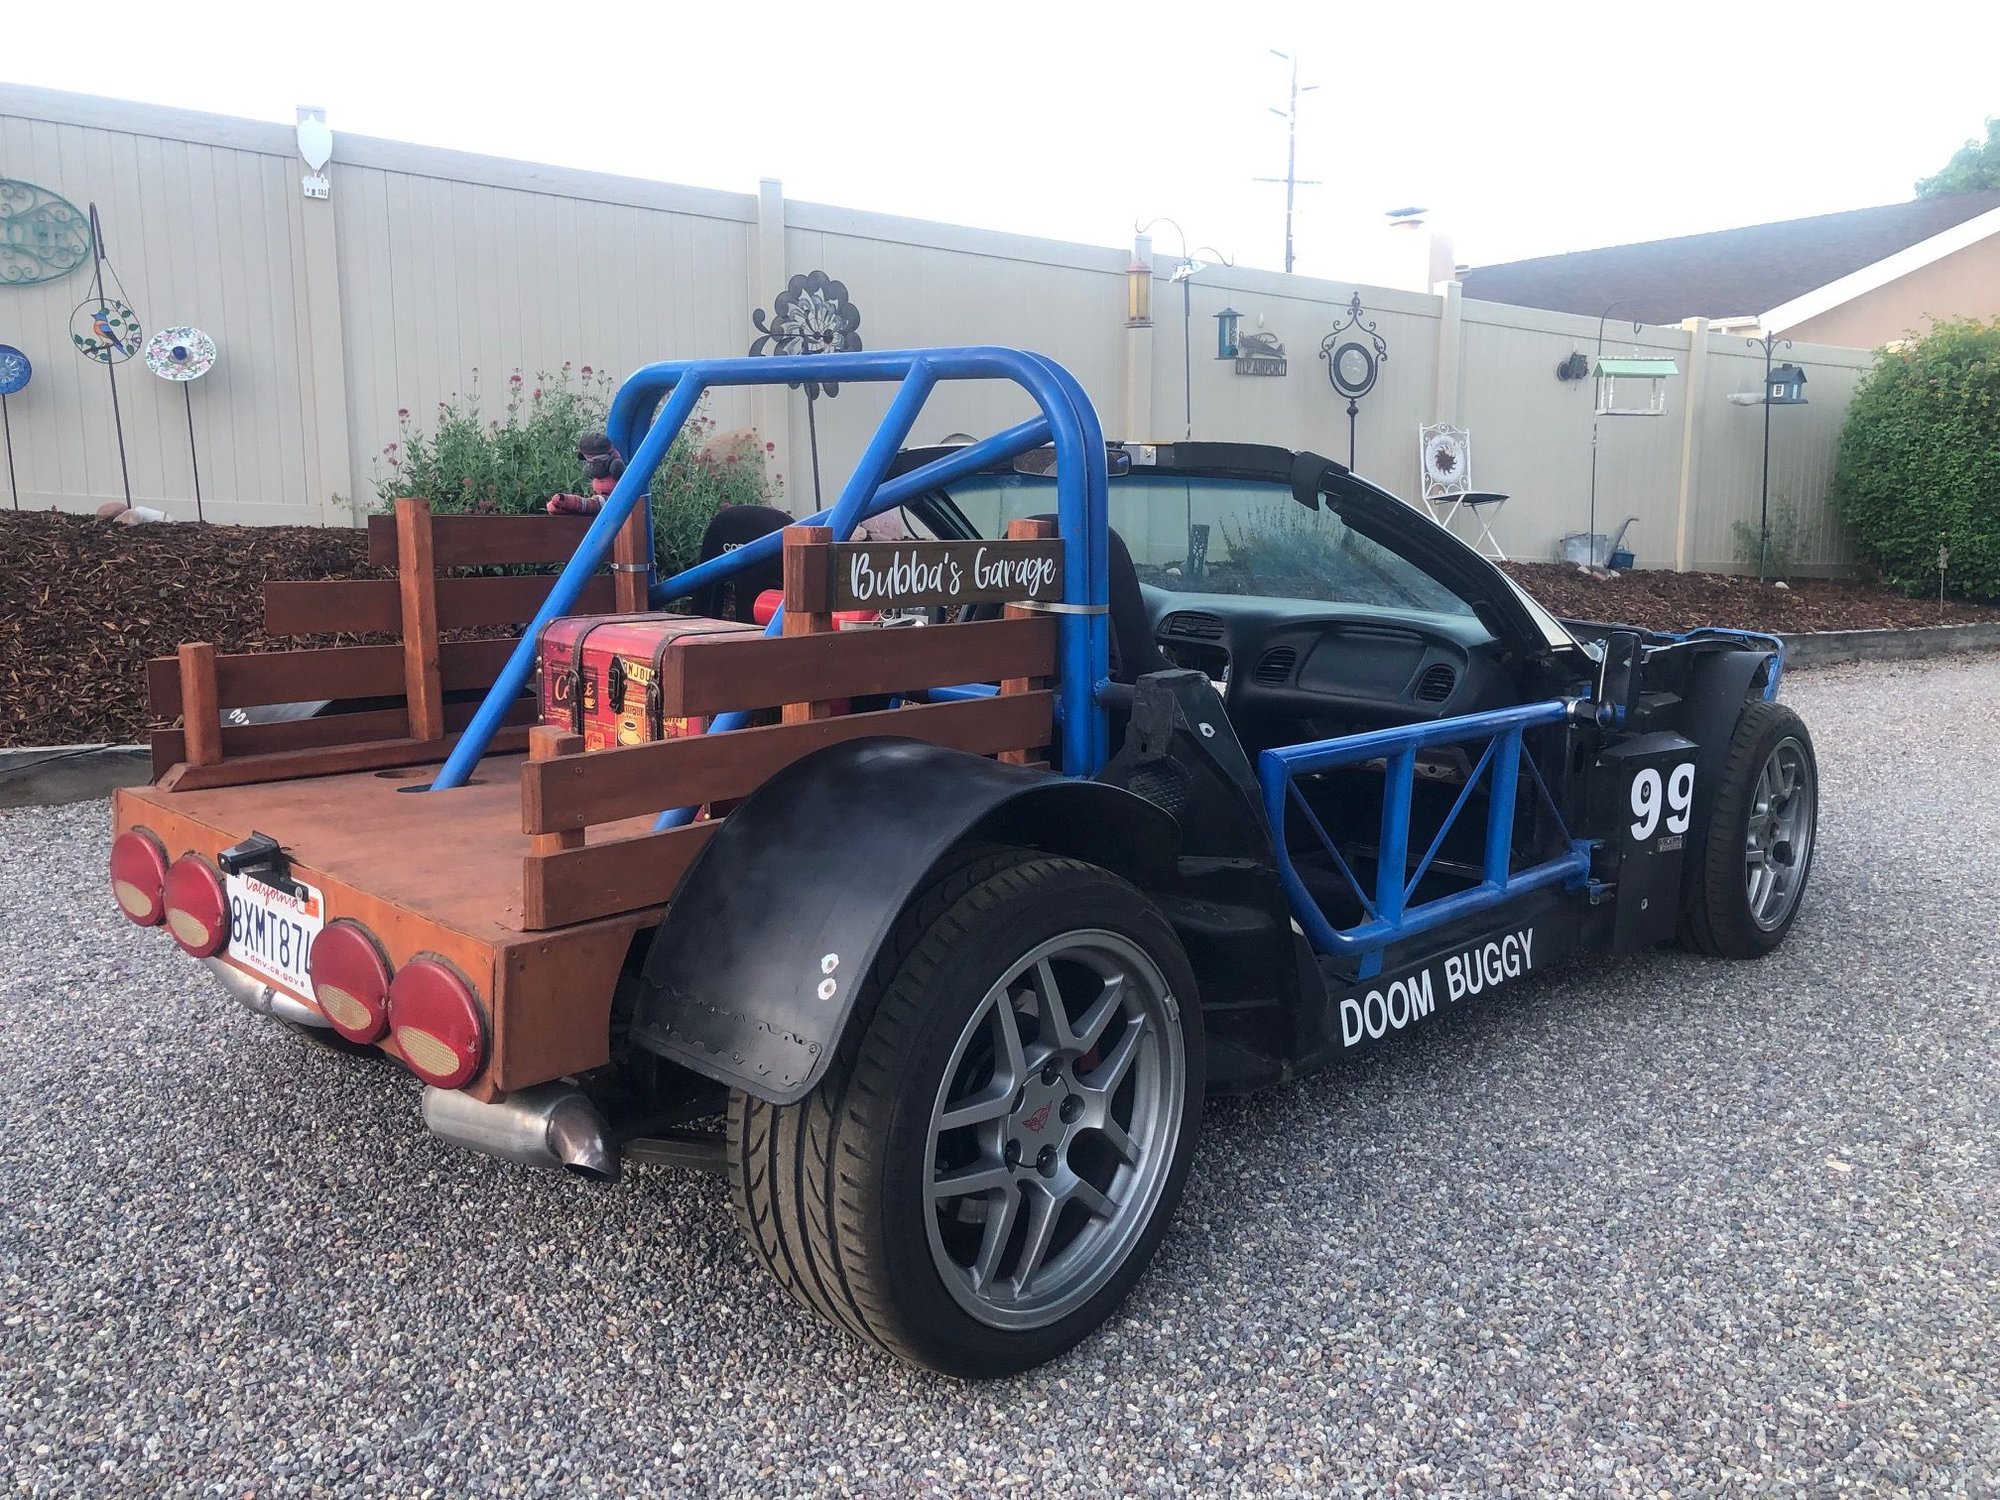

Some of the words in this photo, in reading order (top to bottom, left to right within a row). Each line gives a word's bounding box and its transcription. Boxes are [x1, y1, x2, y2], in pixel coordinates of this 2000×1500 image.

[851, 550, 963, 600] Bubba's
[974, 547, 1056, 597] Garage
[1630, 763, 1696, 841] 99
[250, 954, 299, 985] dmv.ca.gov
[1340, 968, 1435, 1048] DOOM
[1444, 928, 1534, 1002] BUGGY
